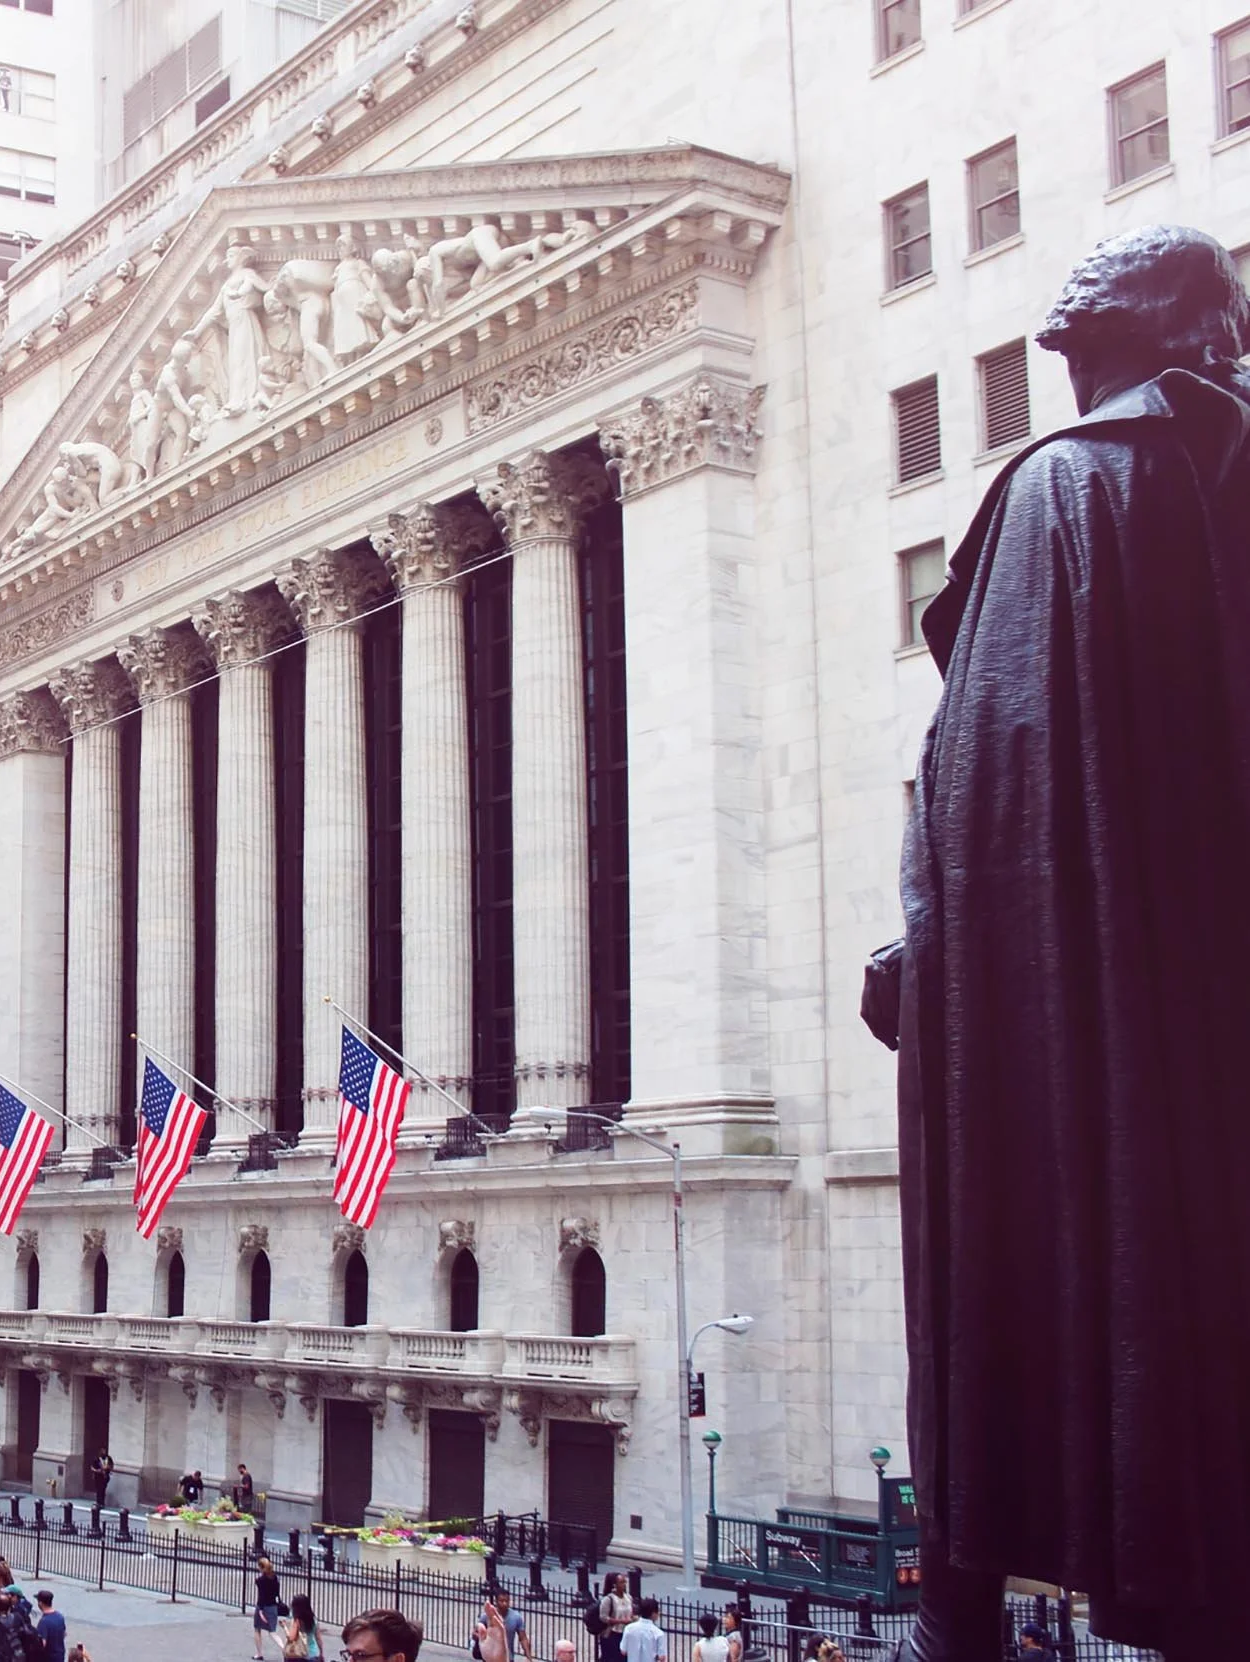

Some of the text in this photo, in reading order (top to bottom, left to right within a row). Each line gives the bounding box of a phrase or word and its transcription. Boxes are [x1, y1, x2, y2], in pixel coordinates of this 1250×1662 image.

[138, 436, 409, 591] NEW YORK STOCK EXCHANGE
[898, 1484, 914, 1494] WAL
[765, 1529, 801, 1547] Subway
[895, 1548, 914, 1557] Broad
